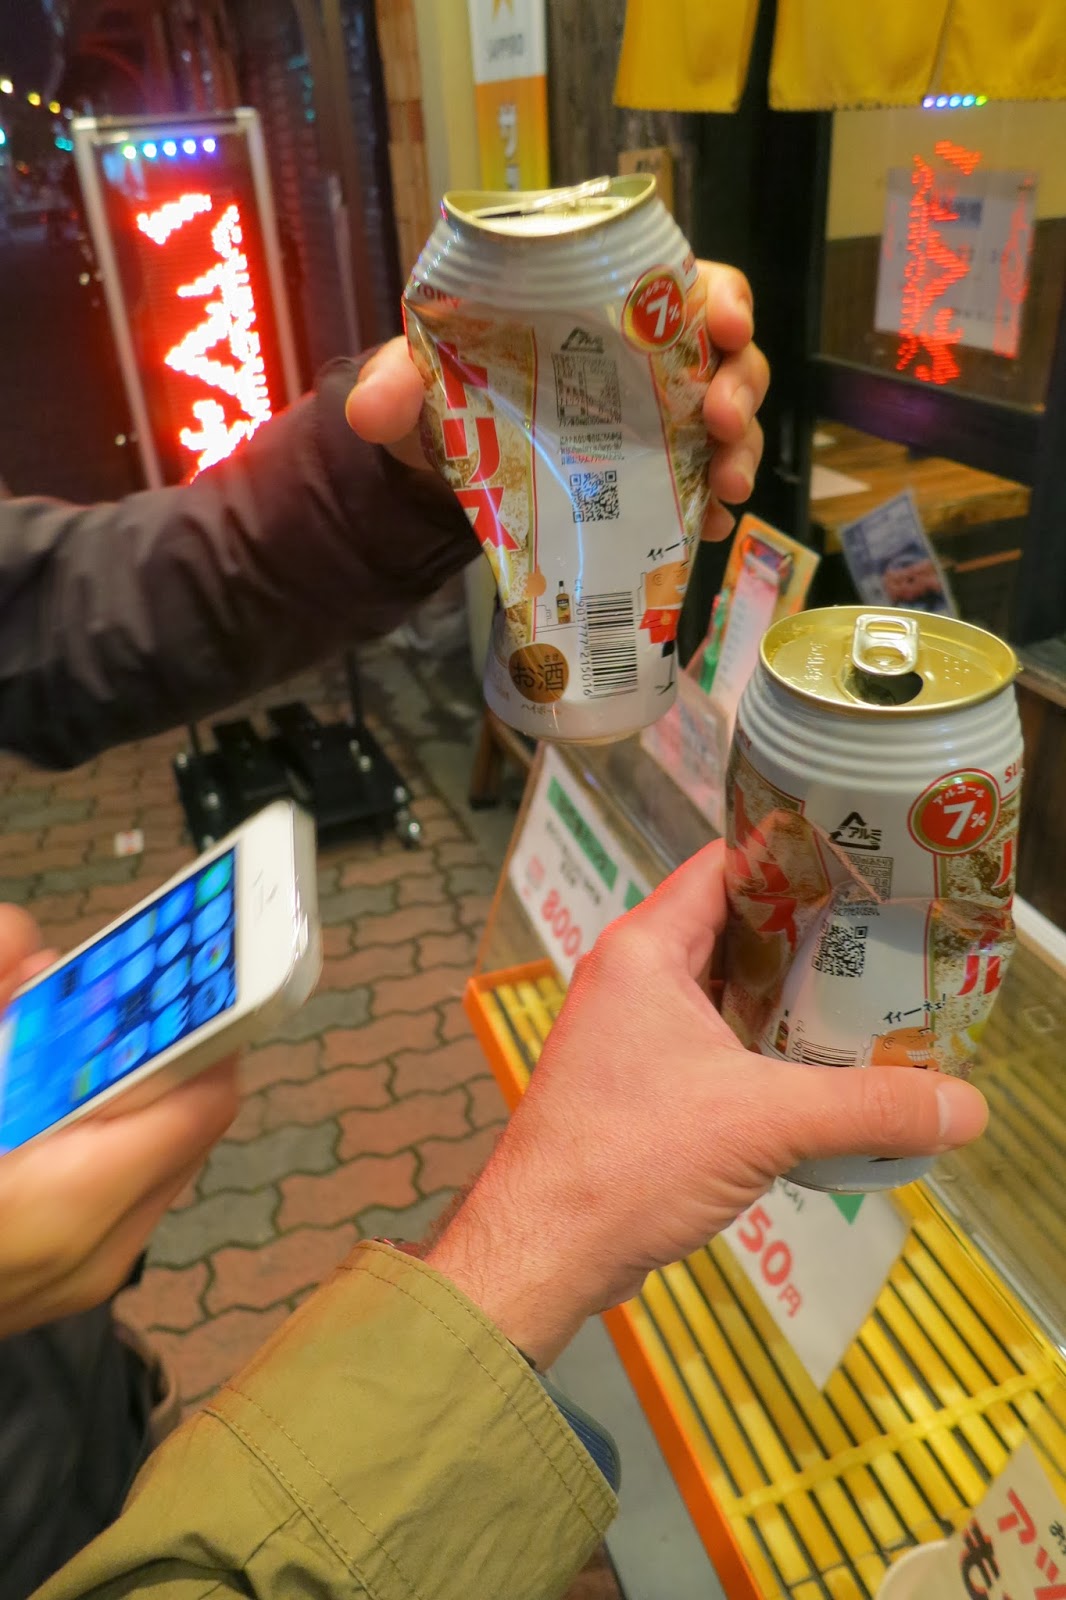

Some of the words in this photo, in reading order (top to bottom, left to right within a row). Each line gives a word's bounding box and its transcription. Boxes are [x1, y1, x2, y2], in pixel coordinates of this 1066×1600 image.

[932, 784, 986, 806] アルコール
[848, 826, 882, 841] アルミ
[944, 800, 987, 840] 7%
[736, 1205, 804, 1318] 50円
